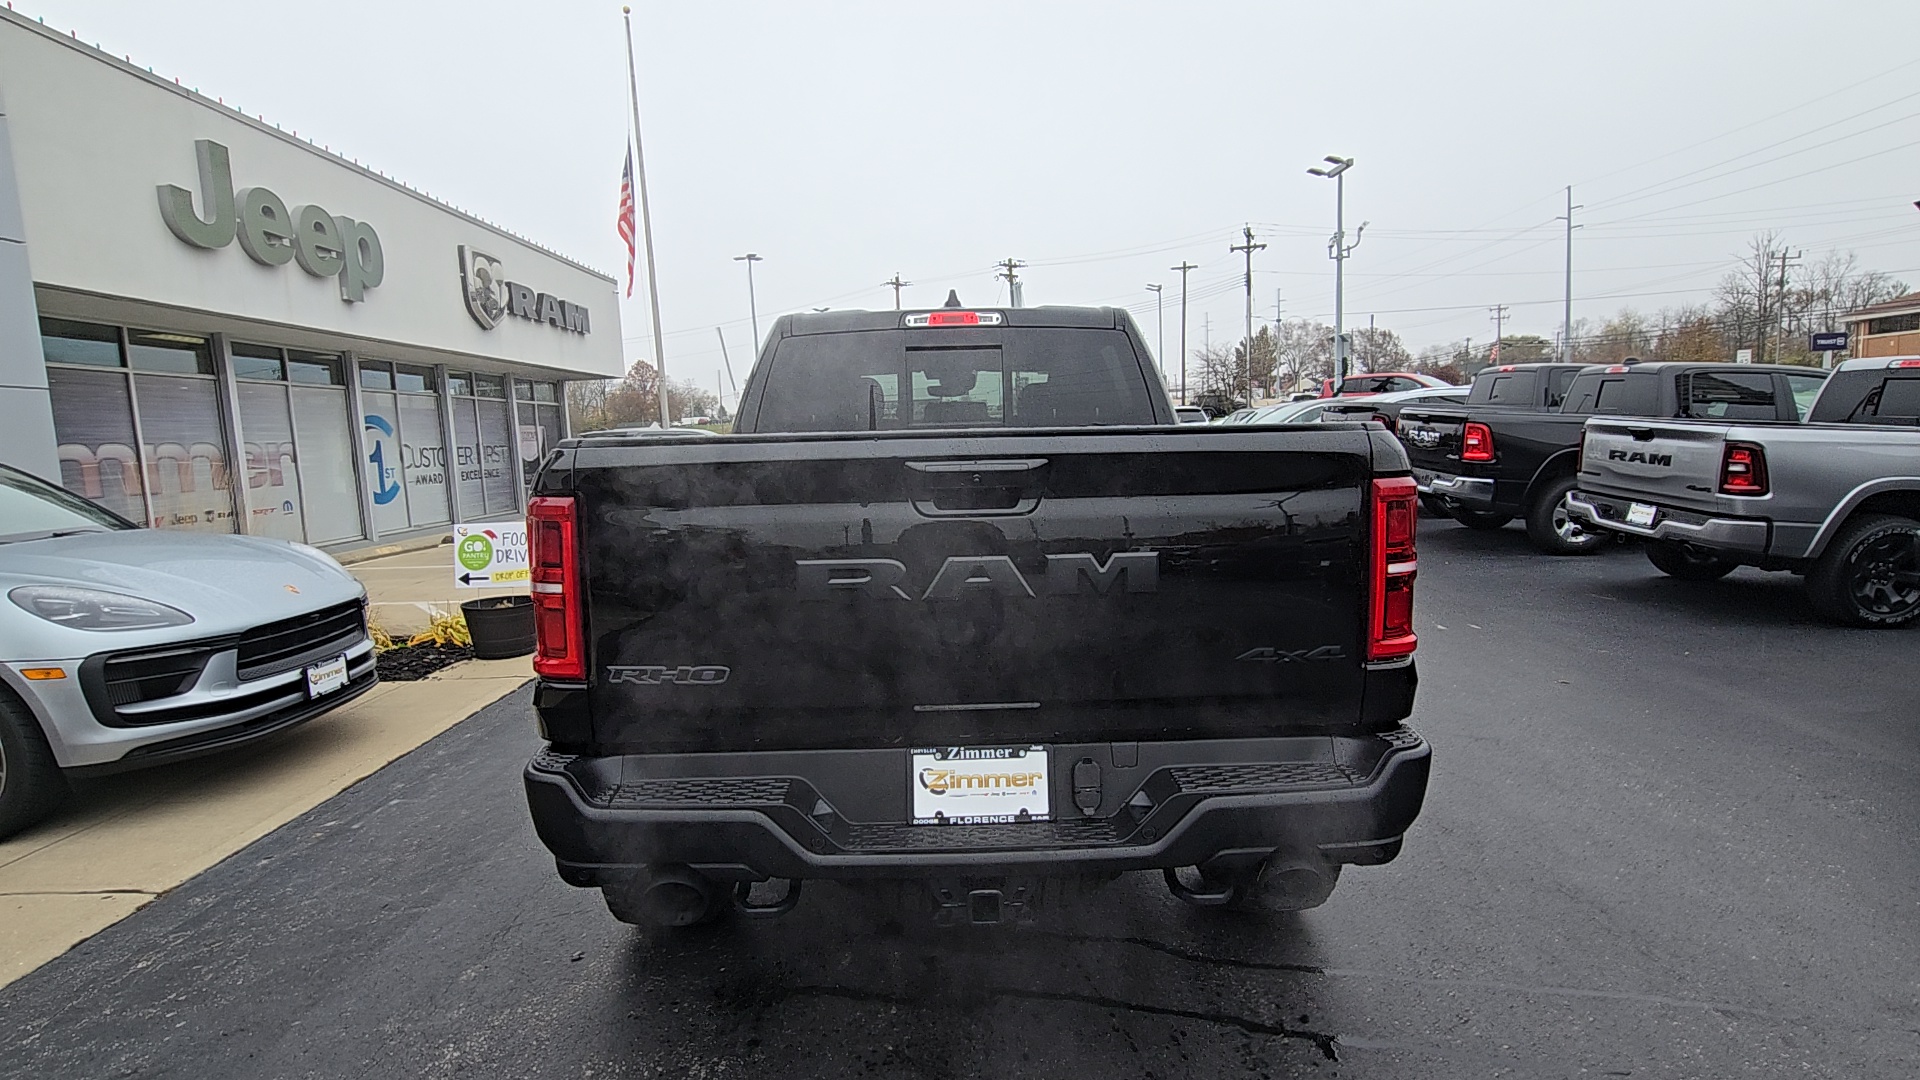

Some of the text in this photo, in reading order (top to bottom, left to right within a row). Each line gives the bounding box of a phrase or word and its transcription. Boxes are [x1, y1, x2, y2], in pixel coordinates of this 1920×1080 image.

[156, 139, 384, 303] Jeep
[505, 280, 591, 335] RAM
[1409, 430, 1440, 442] RAM
[400, 443, 474, 469] CUSTOER
[1608, 449, 1672, 467] RAM
[416, 468, 501, 486] AWARD EXCELENCE
[172, 513, 198, 525] Jeep
[464, 540, 486, 553] GO!
[502, 532, 528, 546] FOO
[496, 549, 528, 563] DRIV
[495, 570, 530, 580] DROP OFF
[796, 551, 1160, 600] RAM
[606, 665, 730, 684] RHO
[947, 747, 1012, 759] Zimmer
[926, 769, 1043, 790] Zimmer
[949, 816, 1015, 824] FLORENCE
